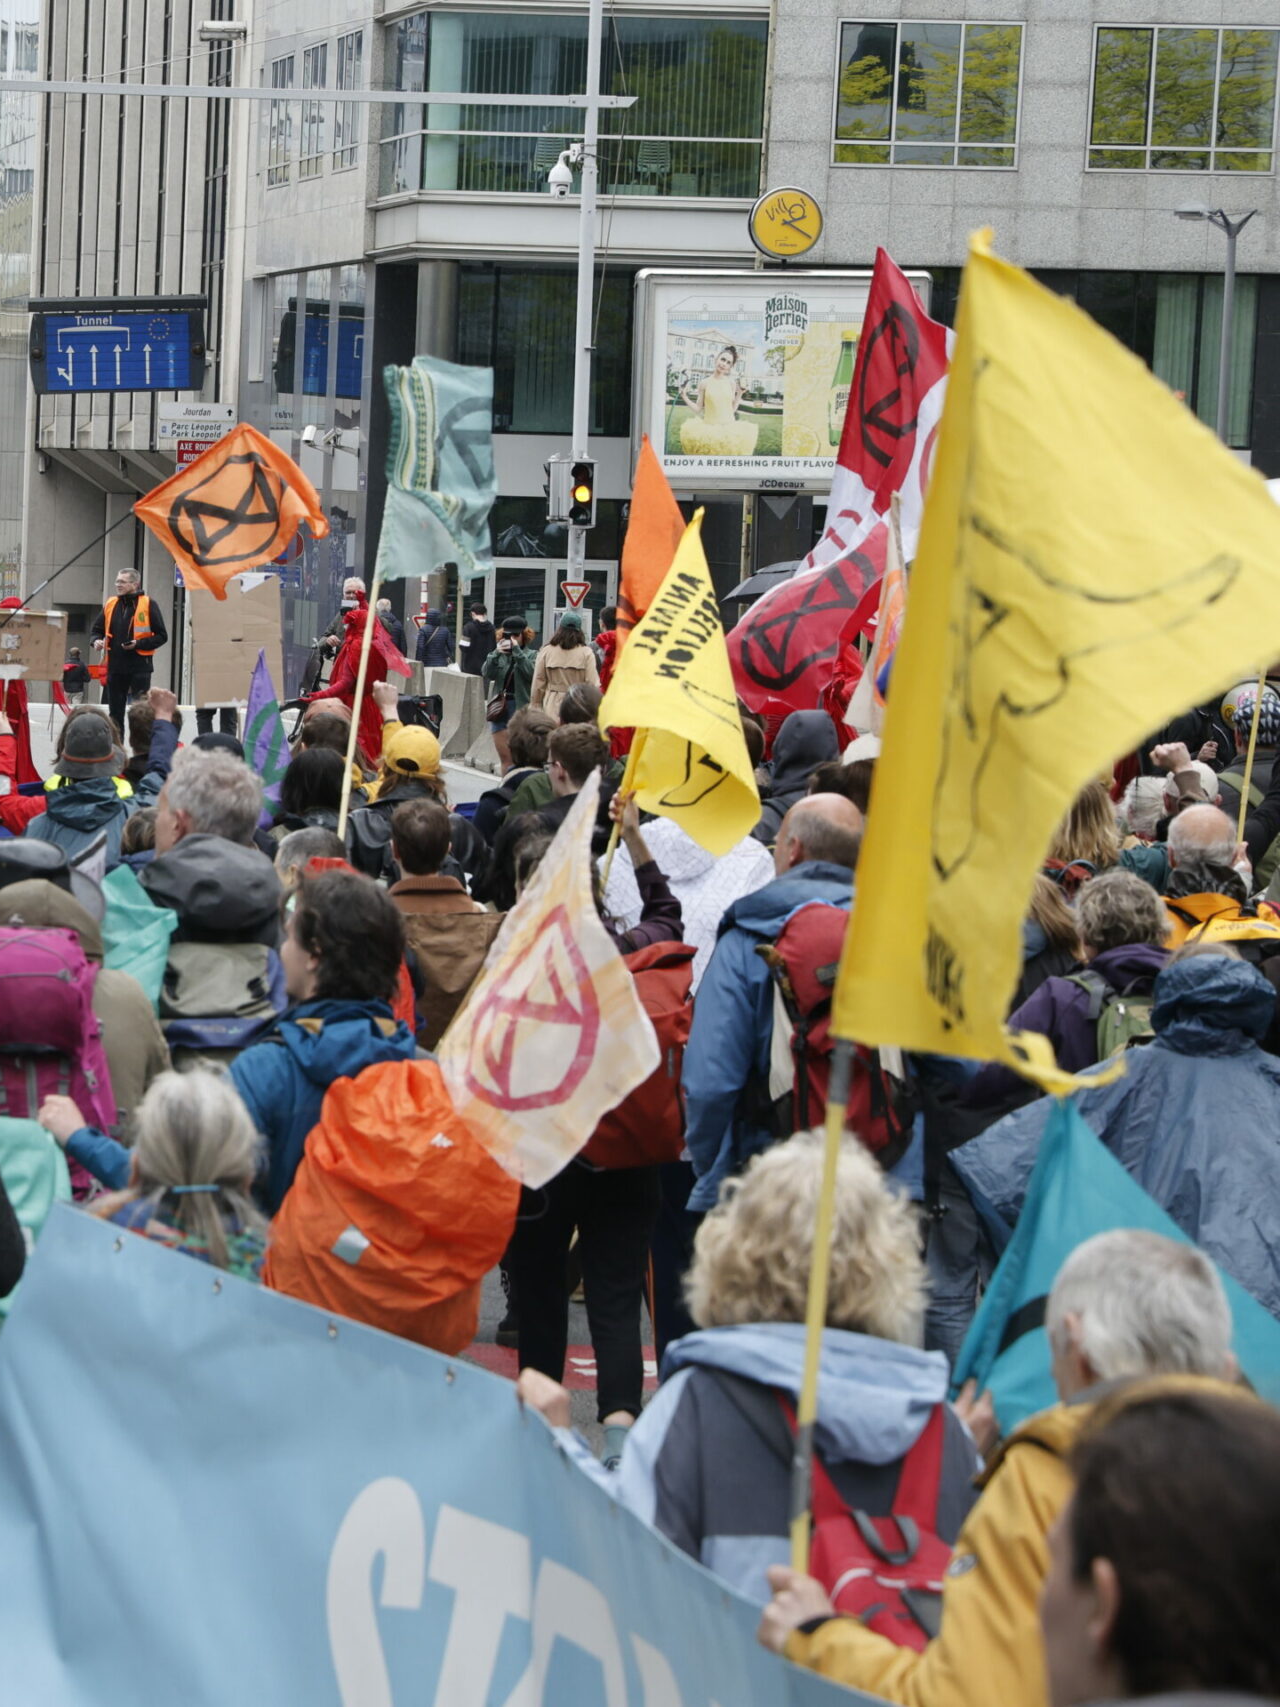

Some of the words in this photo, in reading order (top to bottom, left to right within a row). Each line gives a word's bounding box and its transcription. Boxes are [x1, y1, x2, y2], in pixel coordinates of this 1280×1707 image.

[765, 295, 808, 315] Maison
[75, 315, 113, 326] Tunnel
[182, 407, 212, 417] Jourdan
[171, 422, 190, 431] Parc
[191, 423, 222, 433] Léopold
[191, 430, 222, 439] Leopold
[663, 458, 695, 467] ENJOY
[697, 459, 704, 467] A
[706, 459, 769, 467] REFRESHING
[771, 460, 800, 468] FRUIT
[803, 460, 834, 468] FLAVO
[759, 479, 805, 489] JCDecaux
